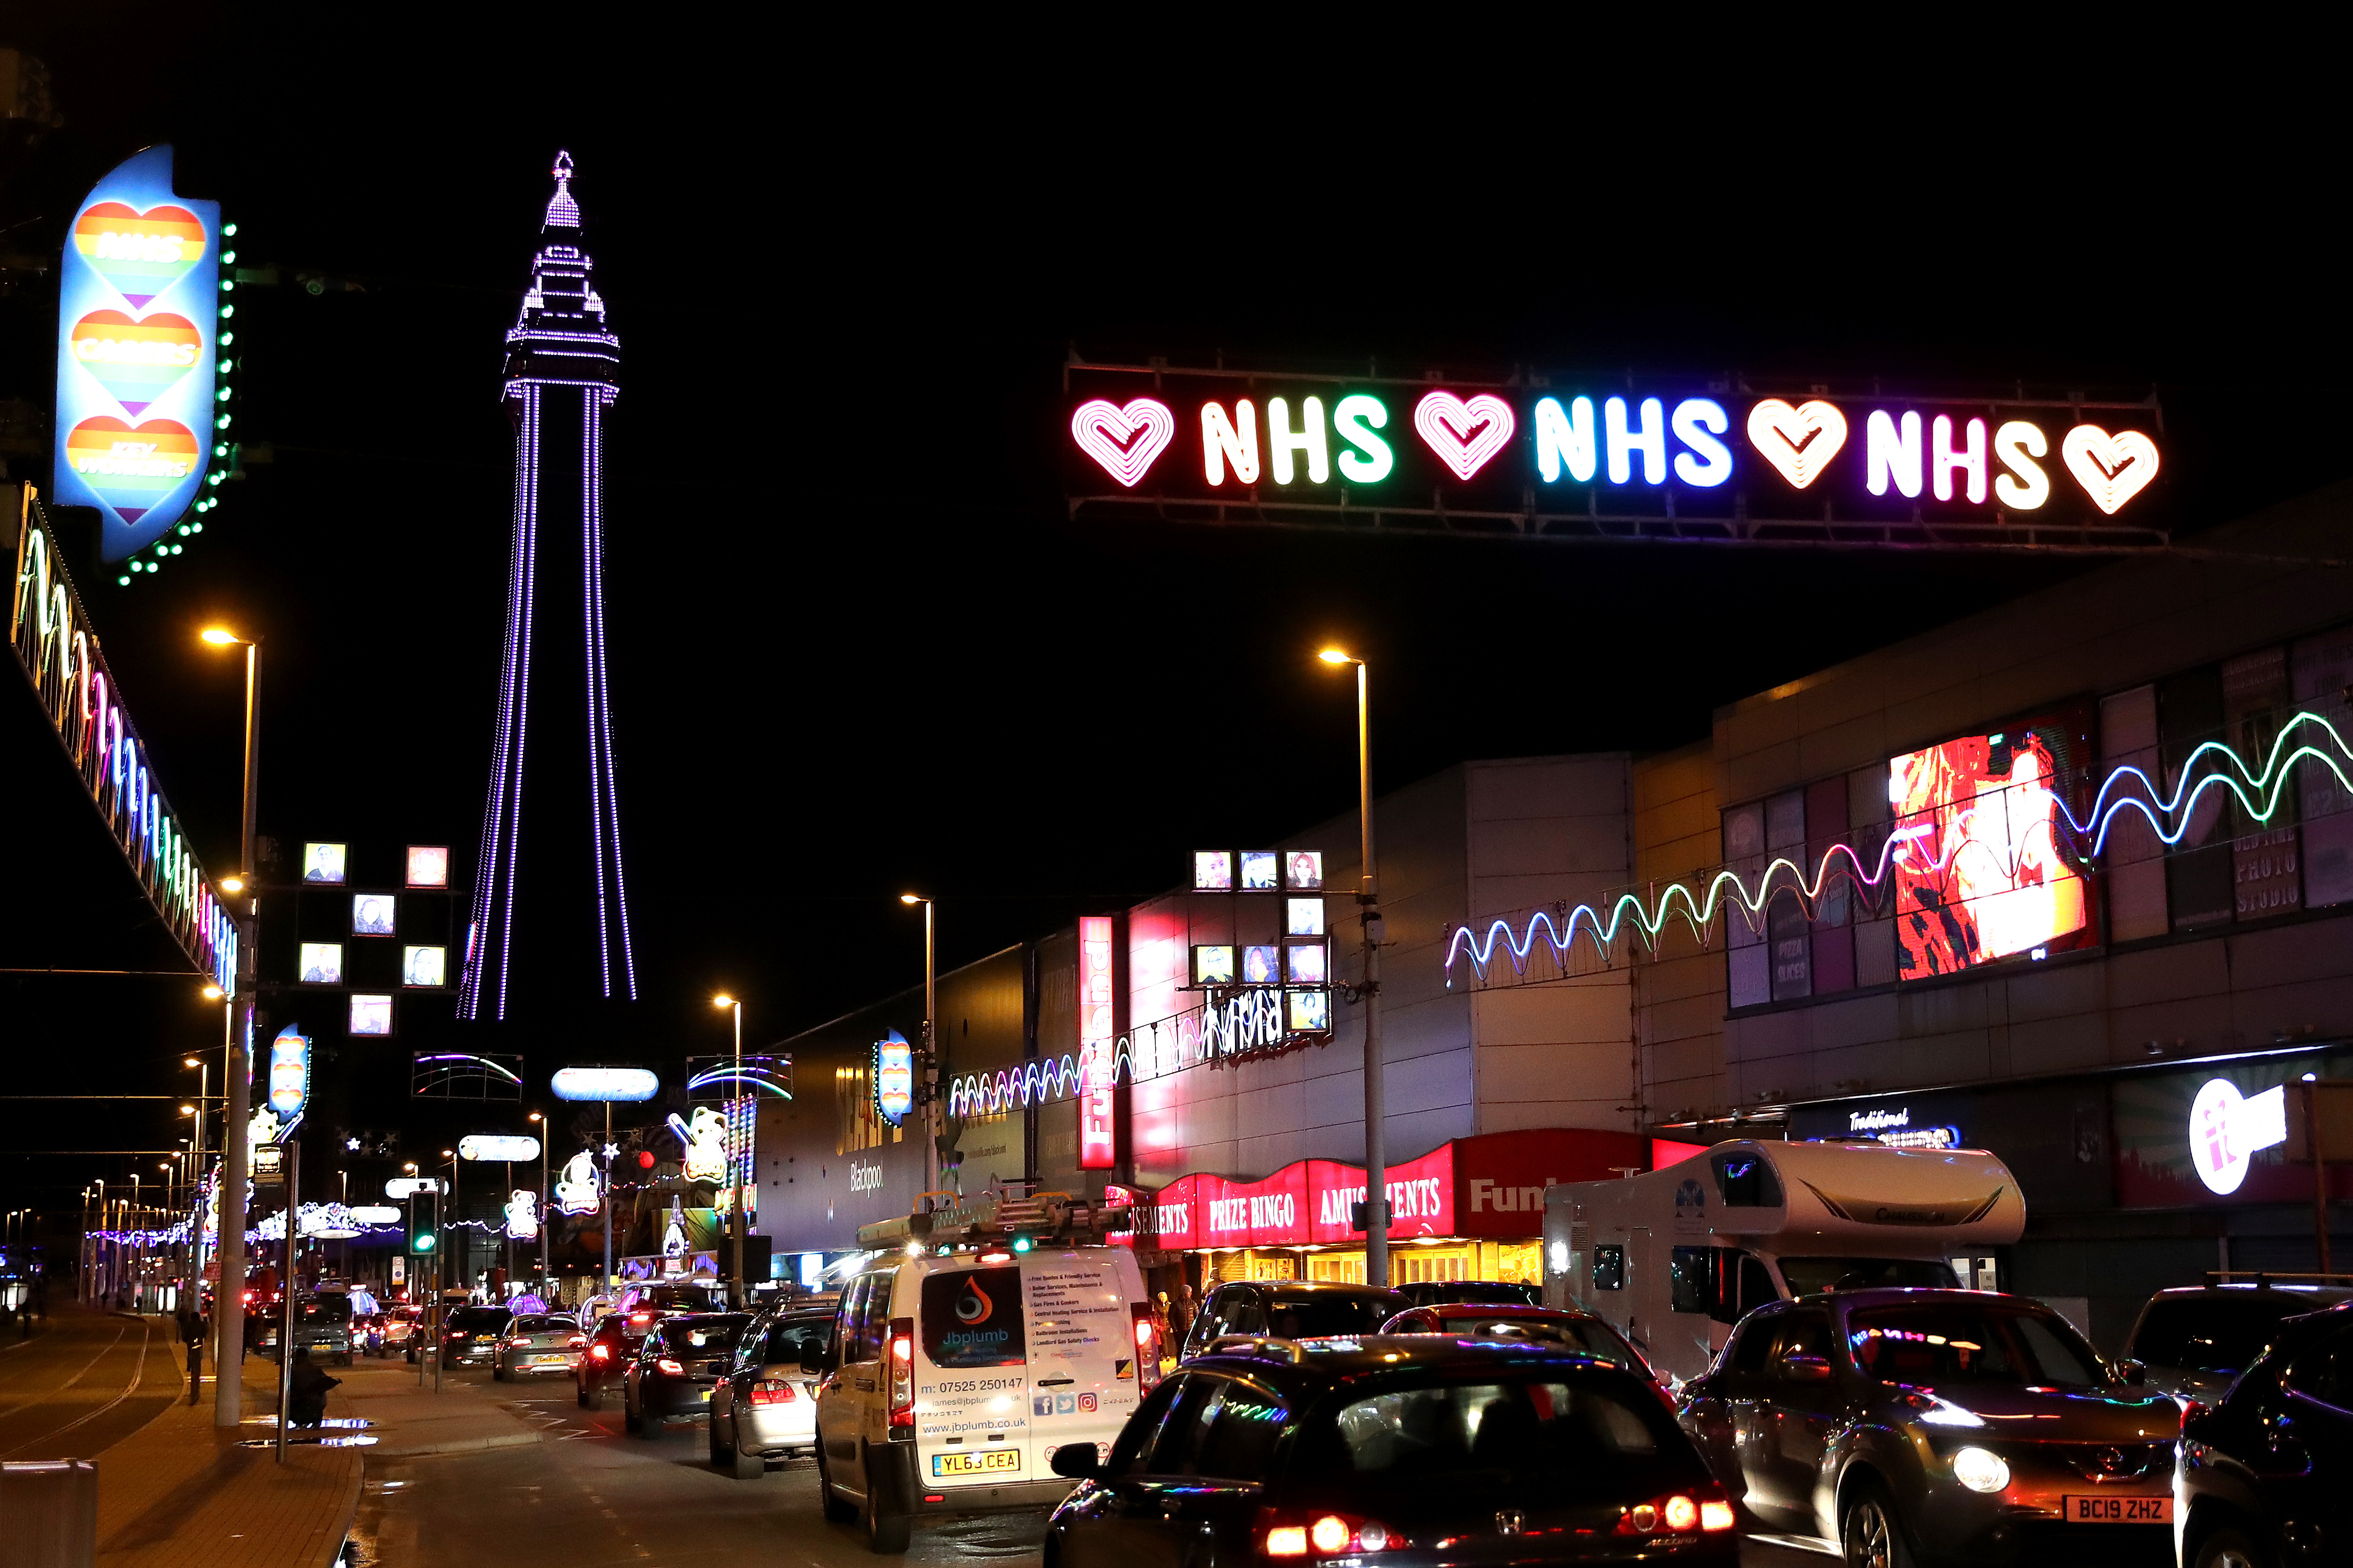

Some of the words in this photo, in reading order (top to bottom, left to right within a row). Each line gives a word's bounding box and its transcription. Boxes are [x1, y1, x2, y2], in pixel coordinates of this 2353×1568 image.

[97, 232, 183, 262] NHS
[110, 442, 157, 459] KEY
[1200, 394, 1393, 486] NHS
[1535, 395, 1733, 487] NHS
[79, 457, 188, 478] WORKERS
[1866, 409, 2049, 510] NHS
[2236, 852, 2297, 883] PHOTO
[2237, 885, 2299, 912] STUDIO
[1084, 940, 1110, 1145] Funland
[1850, 1107, 1909, 1131] Traditional
[851, 1158, 883, 1198] Blackpool
[1210, 1198, 1247, 1231] PRIZE
[1250, 1193, 1294, 1228] BINGO
[1320, 1177, 1441, 1223] AMUENTS
[1111, 1203, 1188, 1236] USEMENTS
[943, 1329, 1009, 1345] Jbplumb
[921, 1385, 936, 1394] m:
[939, 1381, 976, 1393] 07525
[980, 1378, 1022, 1390] 250147
[933, 1394, 1021, 1407] james@jbplumuk
[923, 1418, 1026, 1433] www.jbplumb.co.uk
[944, 1456, 982, 1471] YL63
[987, 1454, 1015, 1467] CEA
[2079, 1499, 2120, 1518] BC19
[2127, 1500, 2162, 1519] ZHZ
